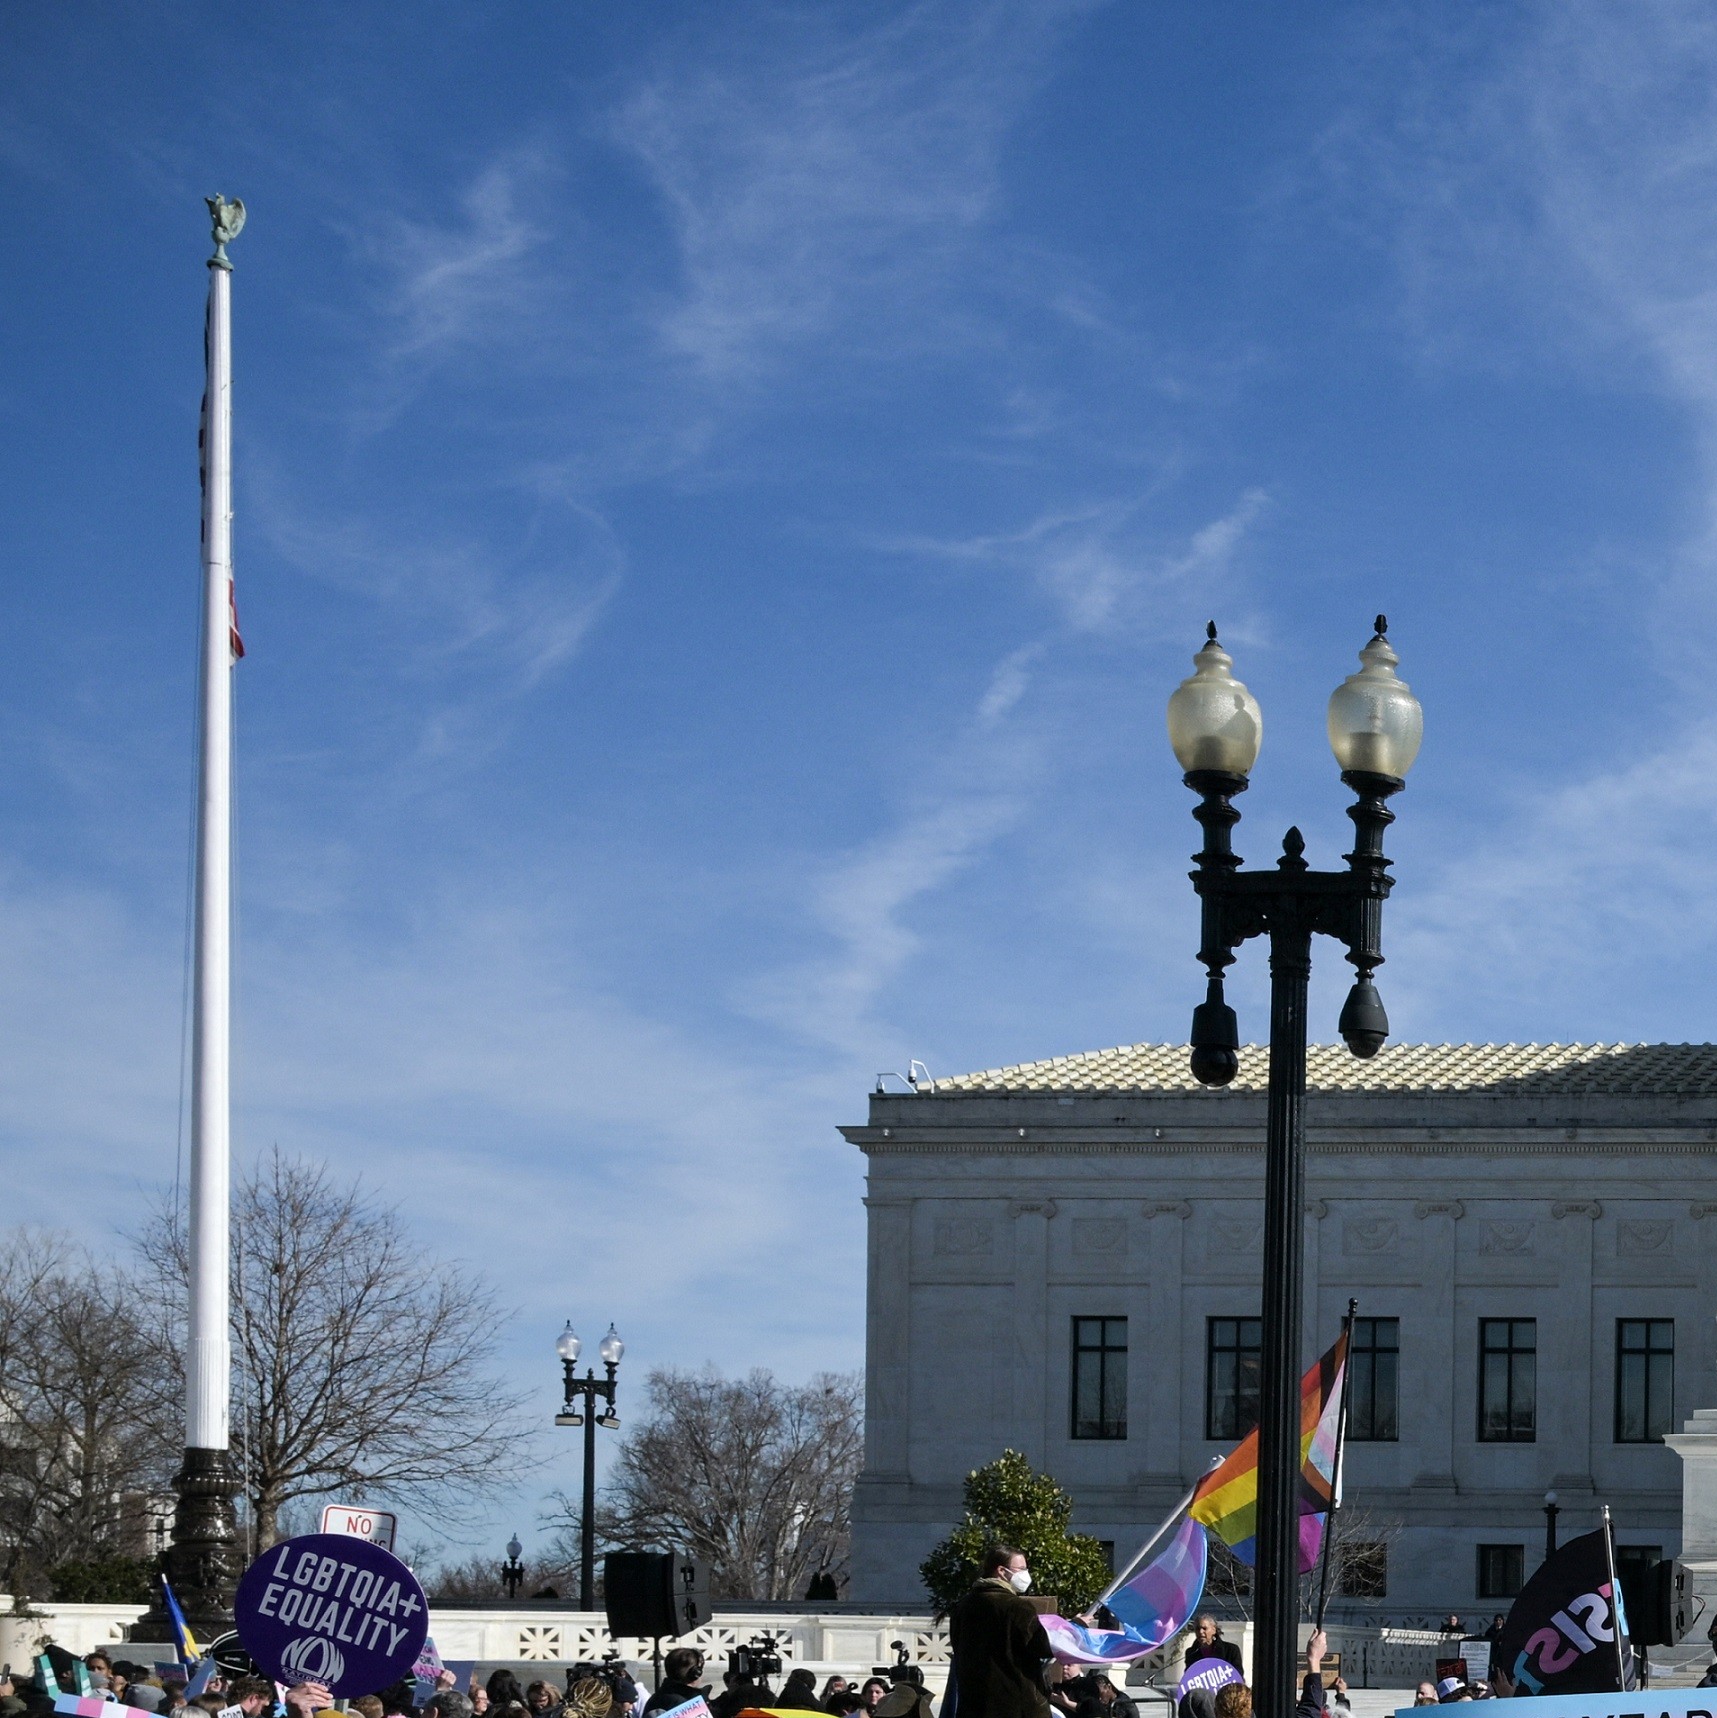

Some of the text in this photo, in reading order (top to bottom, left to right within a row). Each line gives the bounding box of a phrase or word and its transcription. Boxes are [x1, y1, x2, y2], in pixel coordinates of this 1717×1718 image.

[346, 1516, 372, 1535] NO
[273, 1546, 422, 1618] LGBTQIA+
[257, 1582, 410, 1658] EQUALITY
[681, 1700, 703, 1716] WHAT
